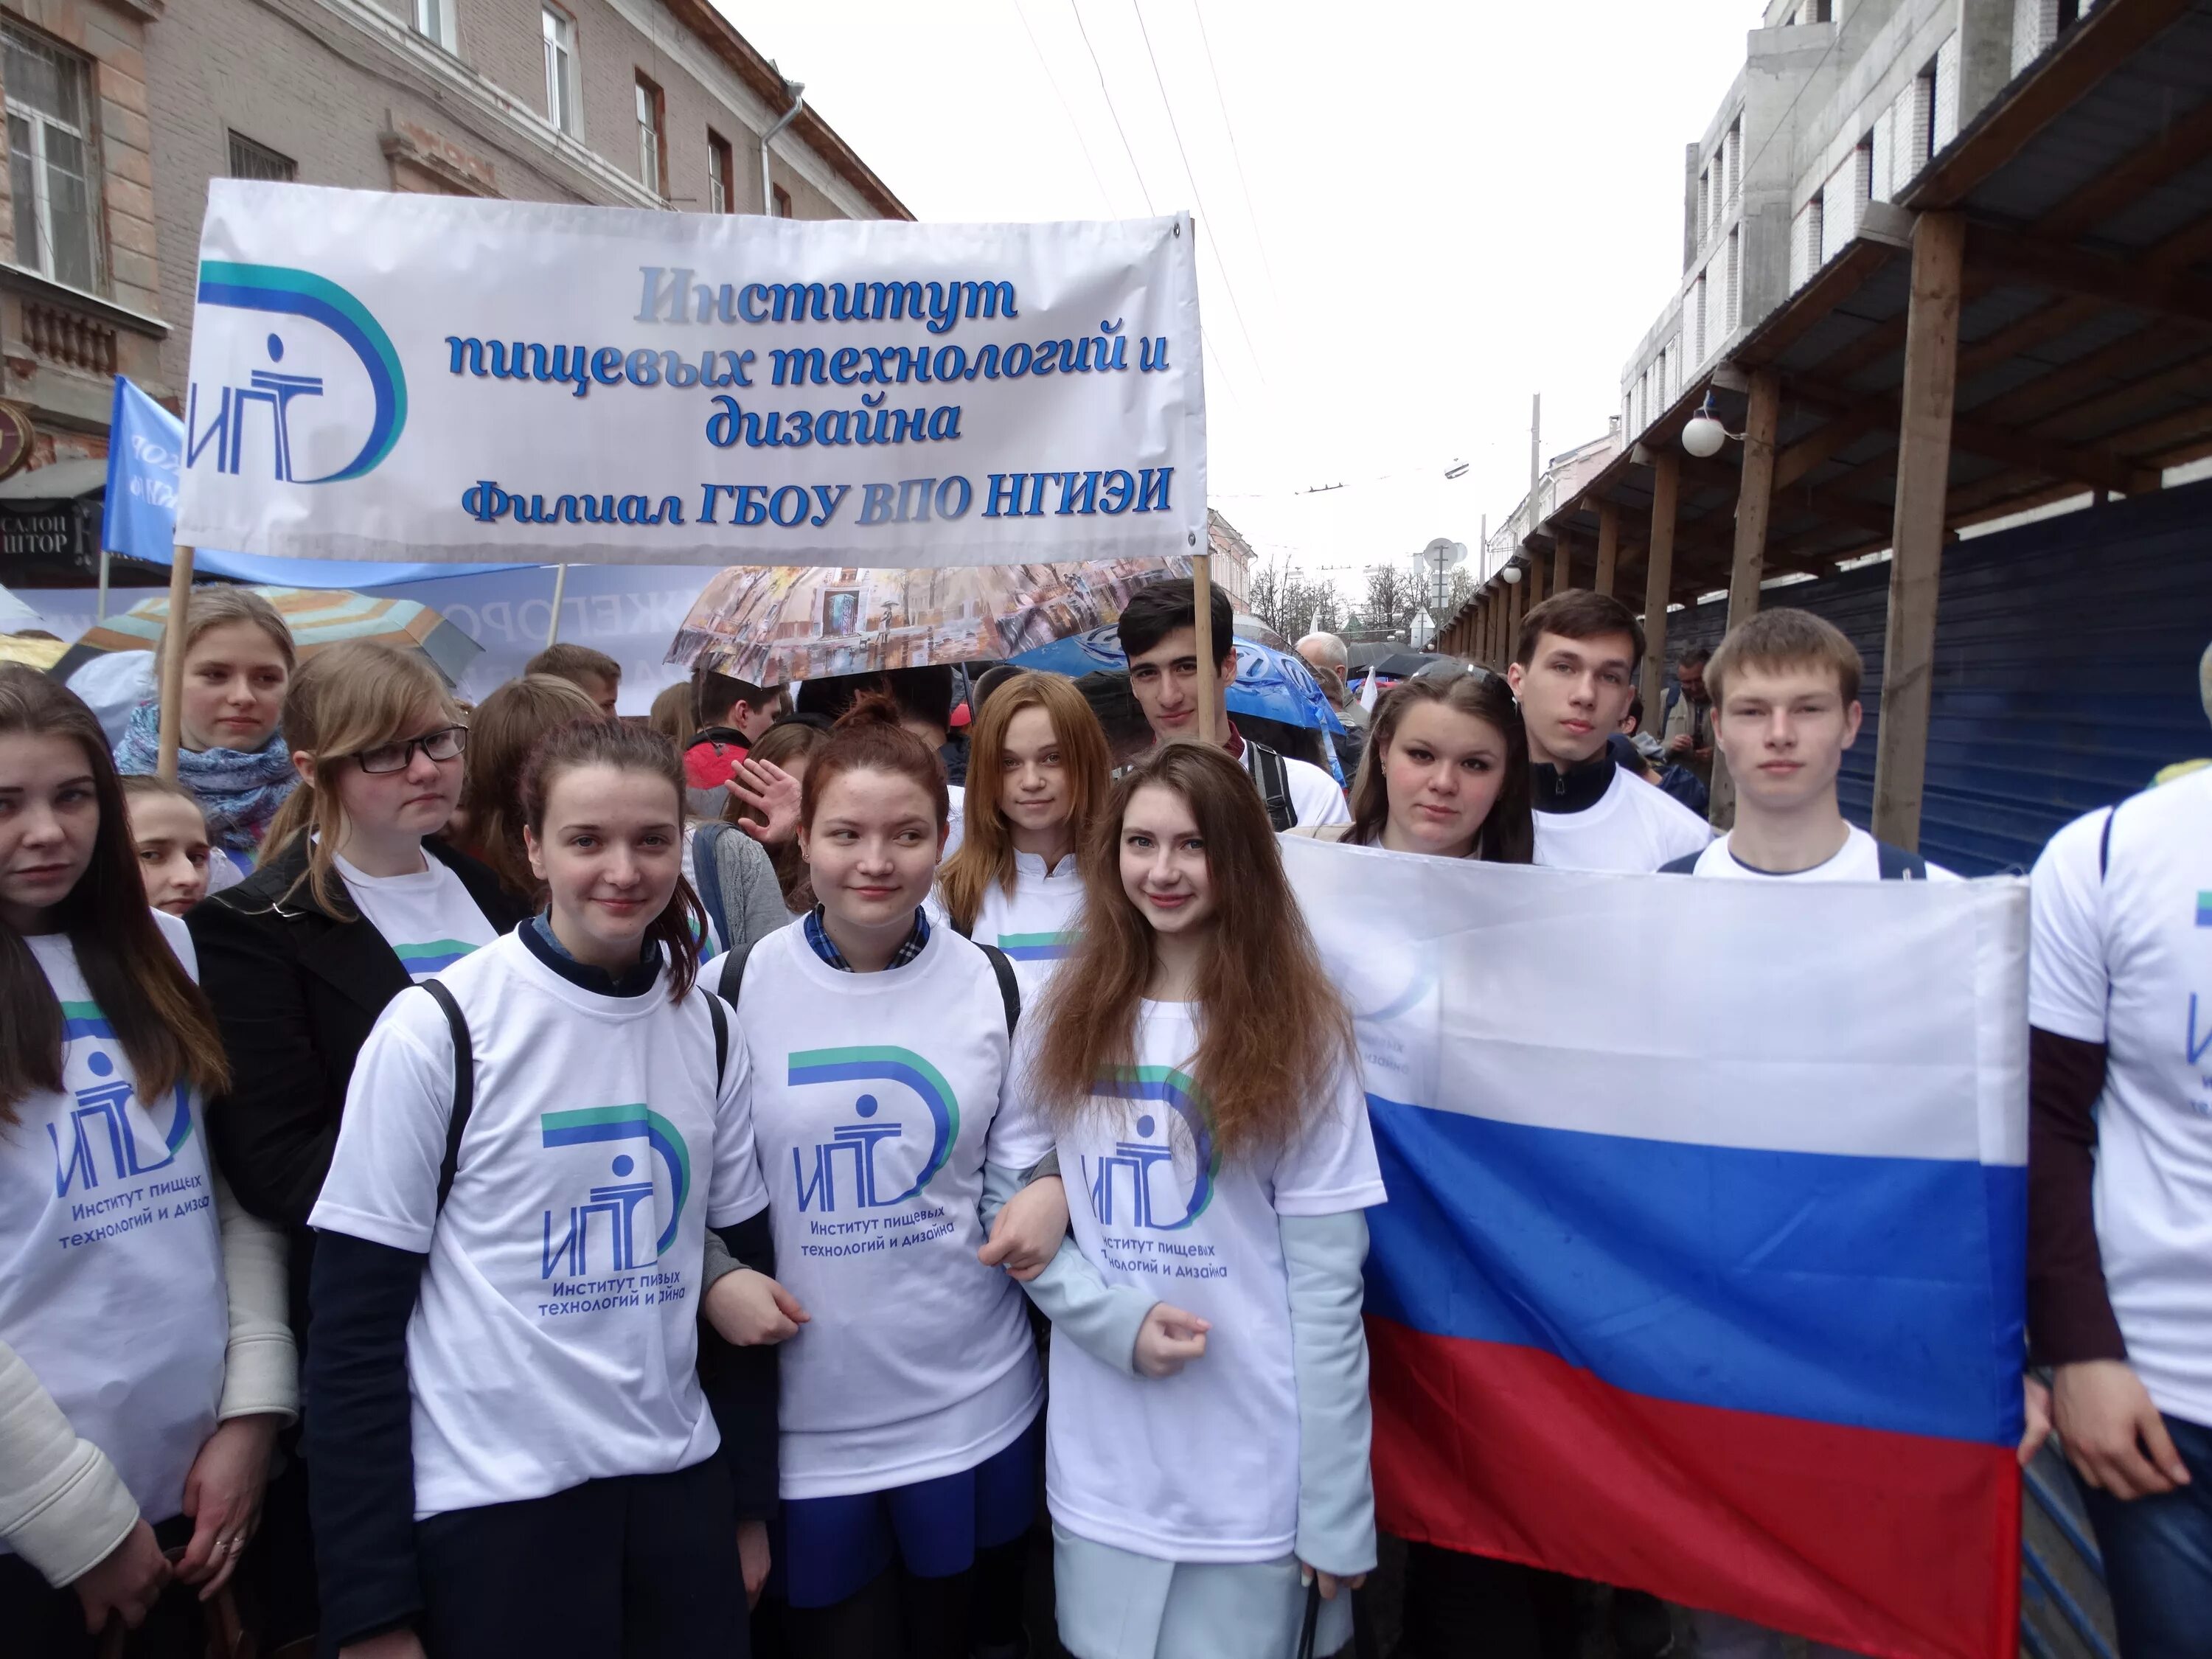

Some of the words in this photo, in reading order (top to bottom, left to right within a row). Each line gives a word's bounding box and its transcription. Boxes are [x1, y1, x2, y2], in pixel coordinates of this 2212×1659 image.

[633, 266, 1018, 333] Институт
[445, 335, 756, 397] пищевых
[768, 317, 1127, 385] технологий
[1140, 336, 1169, 372] и
[706, 390, 961, 448] дизайна
[462, 480, 685, 525] Филиал
[696, 482, 851, 526] ГБОУ
[855, 475, 972, 526] ВПО
[981, 467, 1175, 517] НГИЭИ
[4, 534, 67, 553] ШТОР
[72, 1188, 144, 1221] Институт
[810, 1219, 880, 1236] Институт
[884, 1206, 945, 1228] пищевых
[58, 1206, 153, 1249] технологий
[159, 1207, 169, 1220] и
[801, 1235, 886, 1257] технологий
[889, 1237, 898, 1248] и
[902, 1221, 956, 1247] дизайна
[552, 1276, 636, 1297] Институт
[1163, 1265, 1172, 1276] и
[538, 1290, 639, 1317] технологий
[645, 1294, 655, 1305] и
